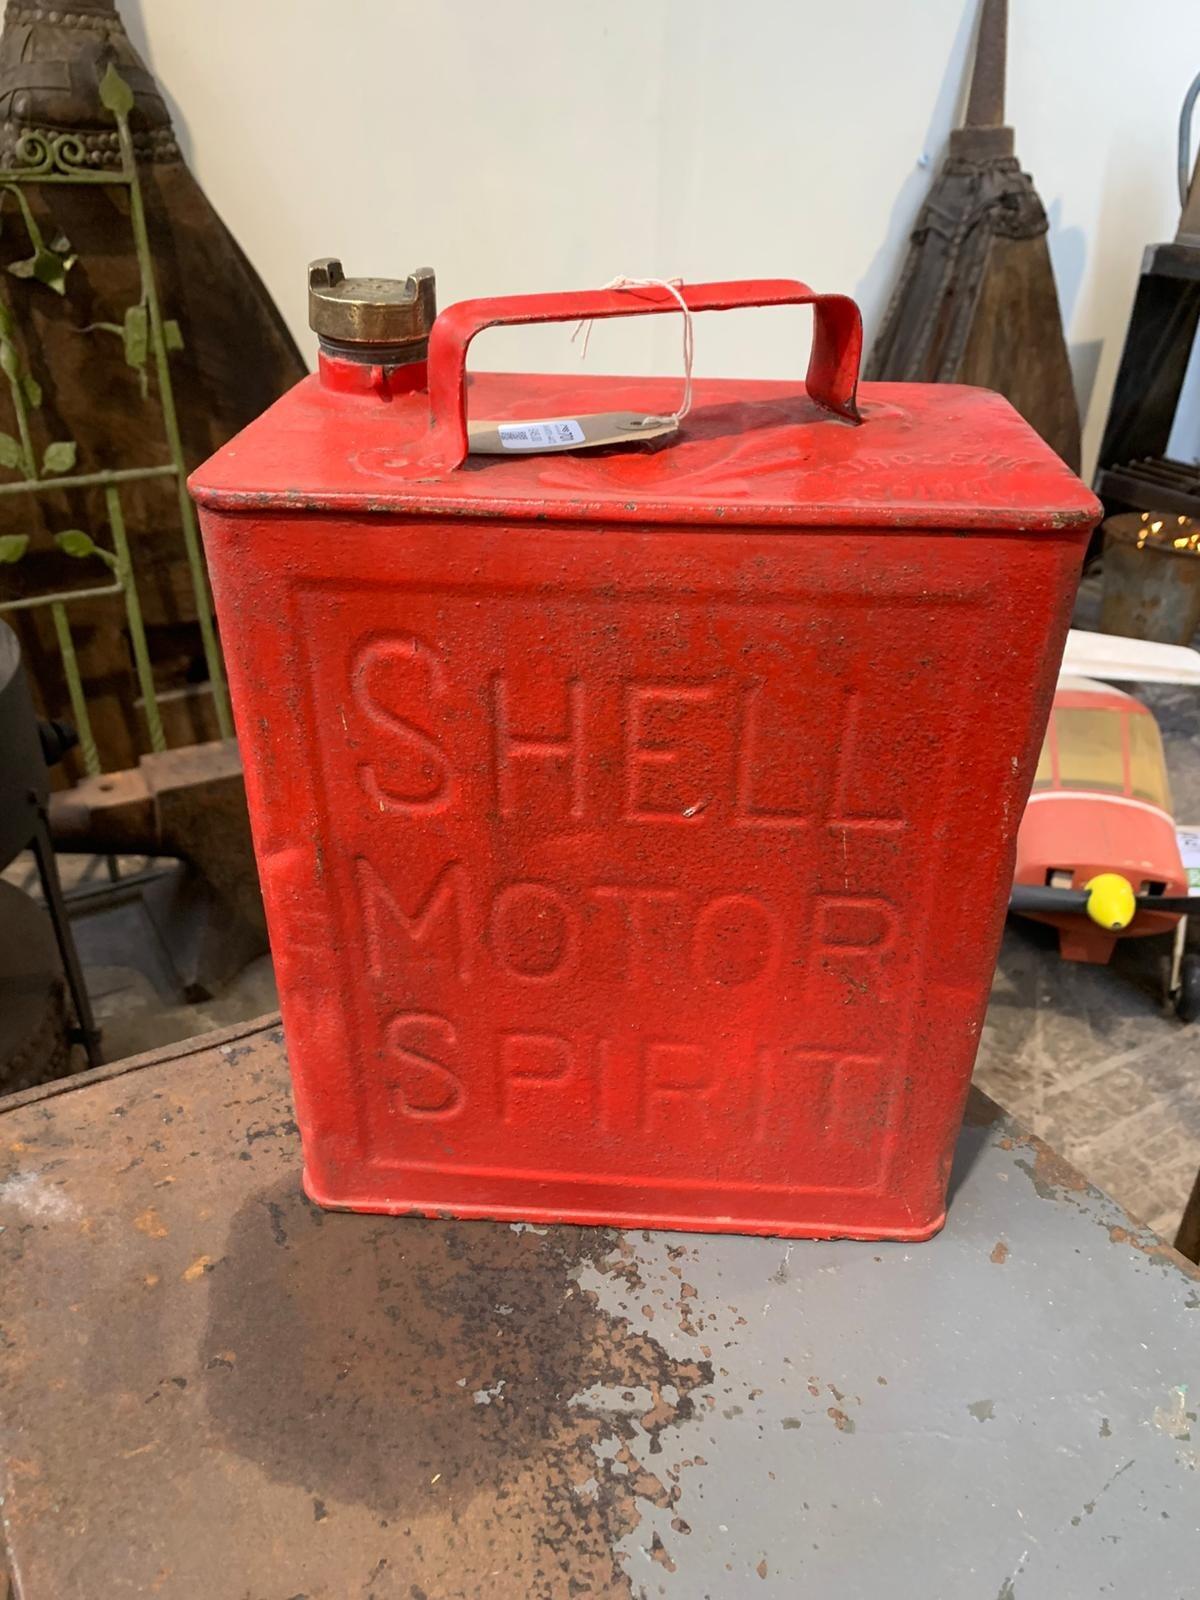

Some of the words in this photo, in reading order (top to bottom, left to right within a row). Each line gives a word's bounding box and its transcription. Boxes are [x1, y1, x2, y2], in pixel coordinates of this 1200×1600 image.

[350, 629, 909, 833] SHELL
[352, 855, 898, 1003] MOTOR
[385, 1010, 884, 1147] SPIRIT
